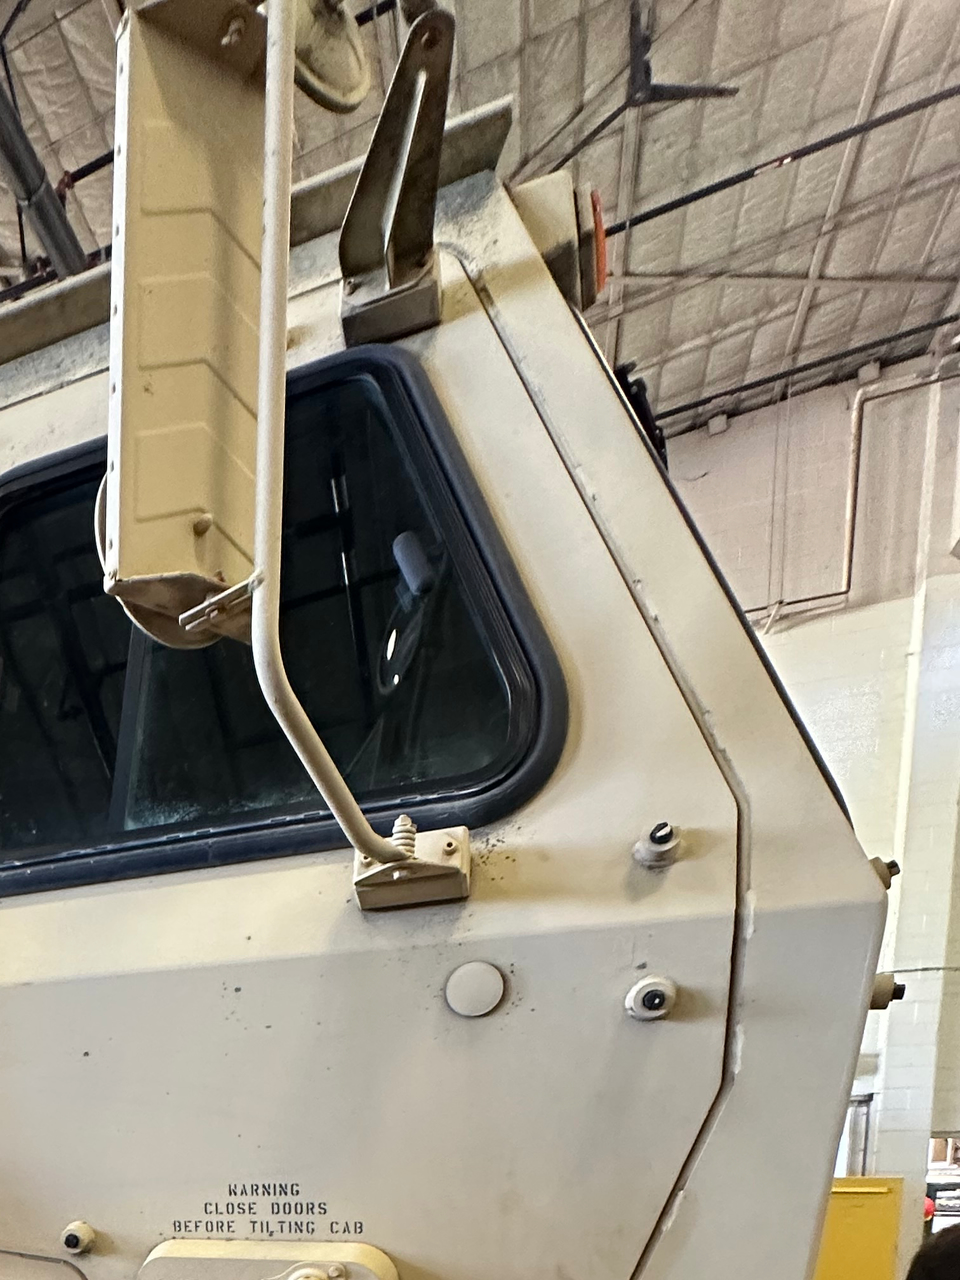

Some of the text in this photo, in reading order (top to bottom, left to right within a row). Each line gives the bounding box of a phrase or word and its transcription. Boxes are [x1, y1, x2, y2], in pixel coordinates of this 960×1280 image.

[228, 1183, 300, 1197] WARNING
[204, 1202, 328, 1215] CLOSE DOORS
[173, 1220, 364, 1235] BEFORE TILTING CAB
